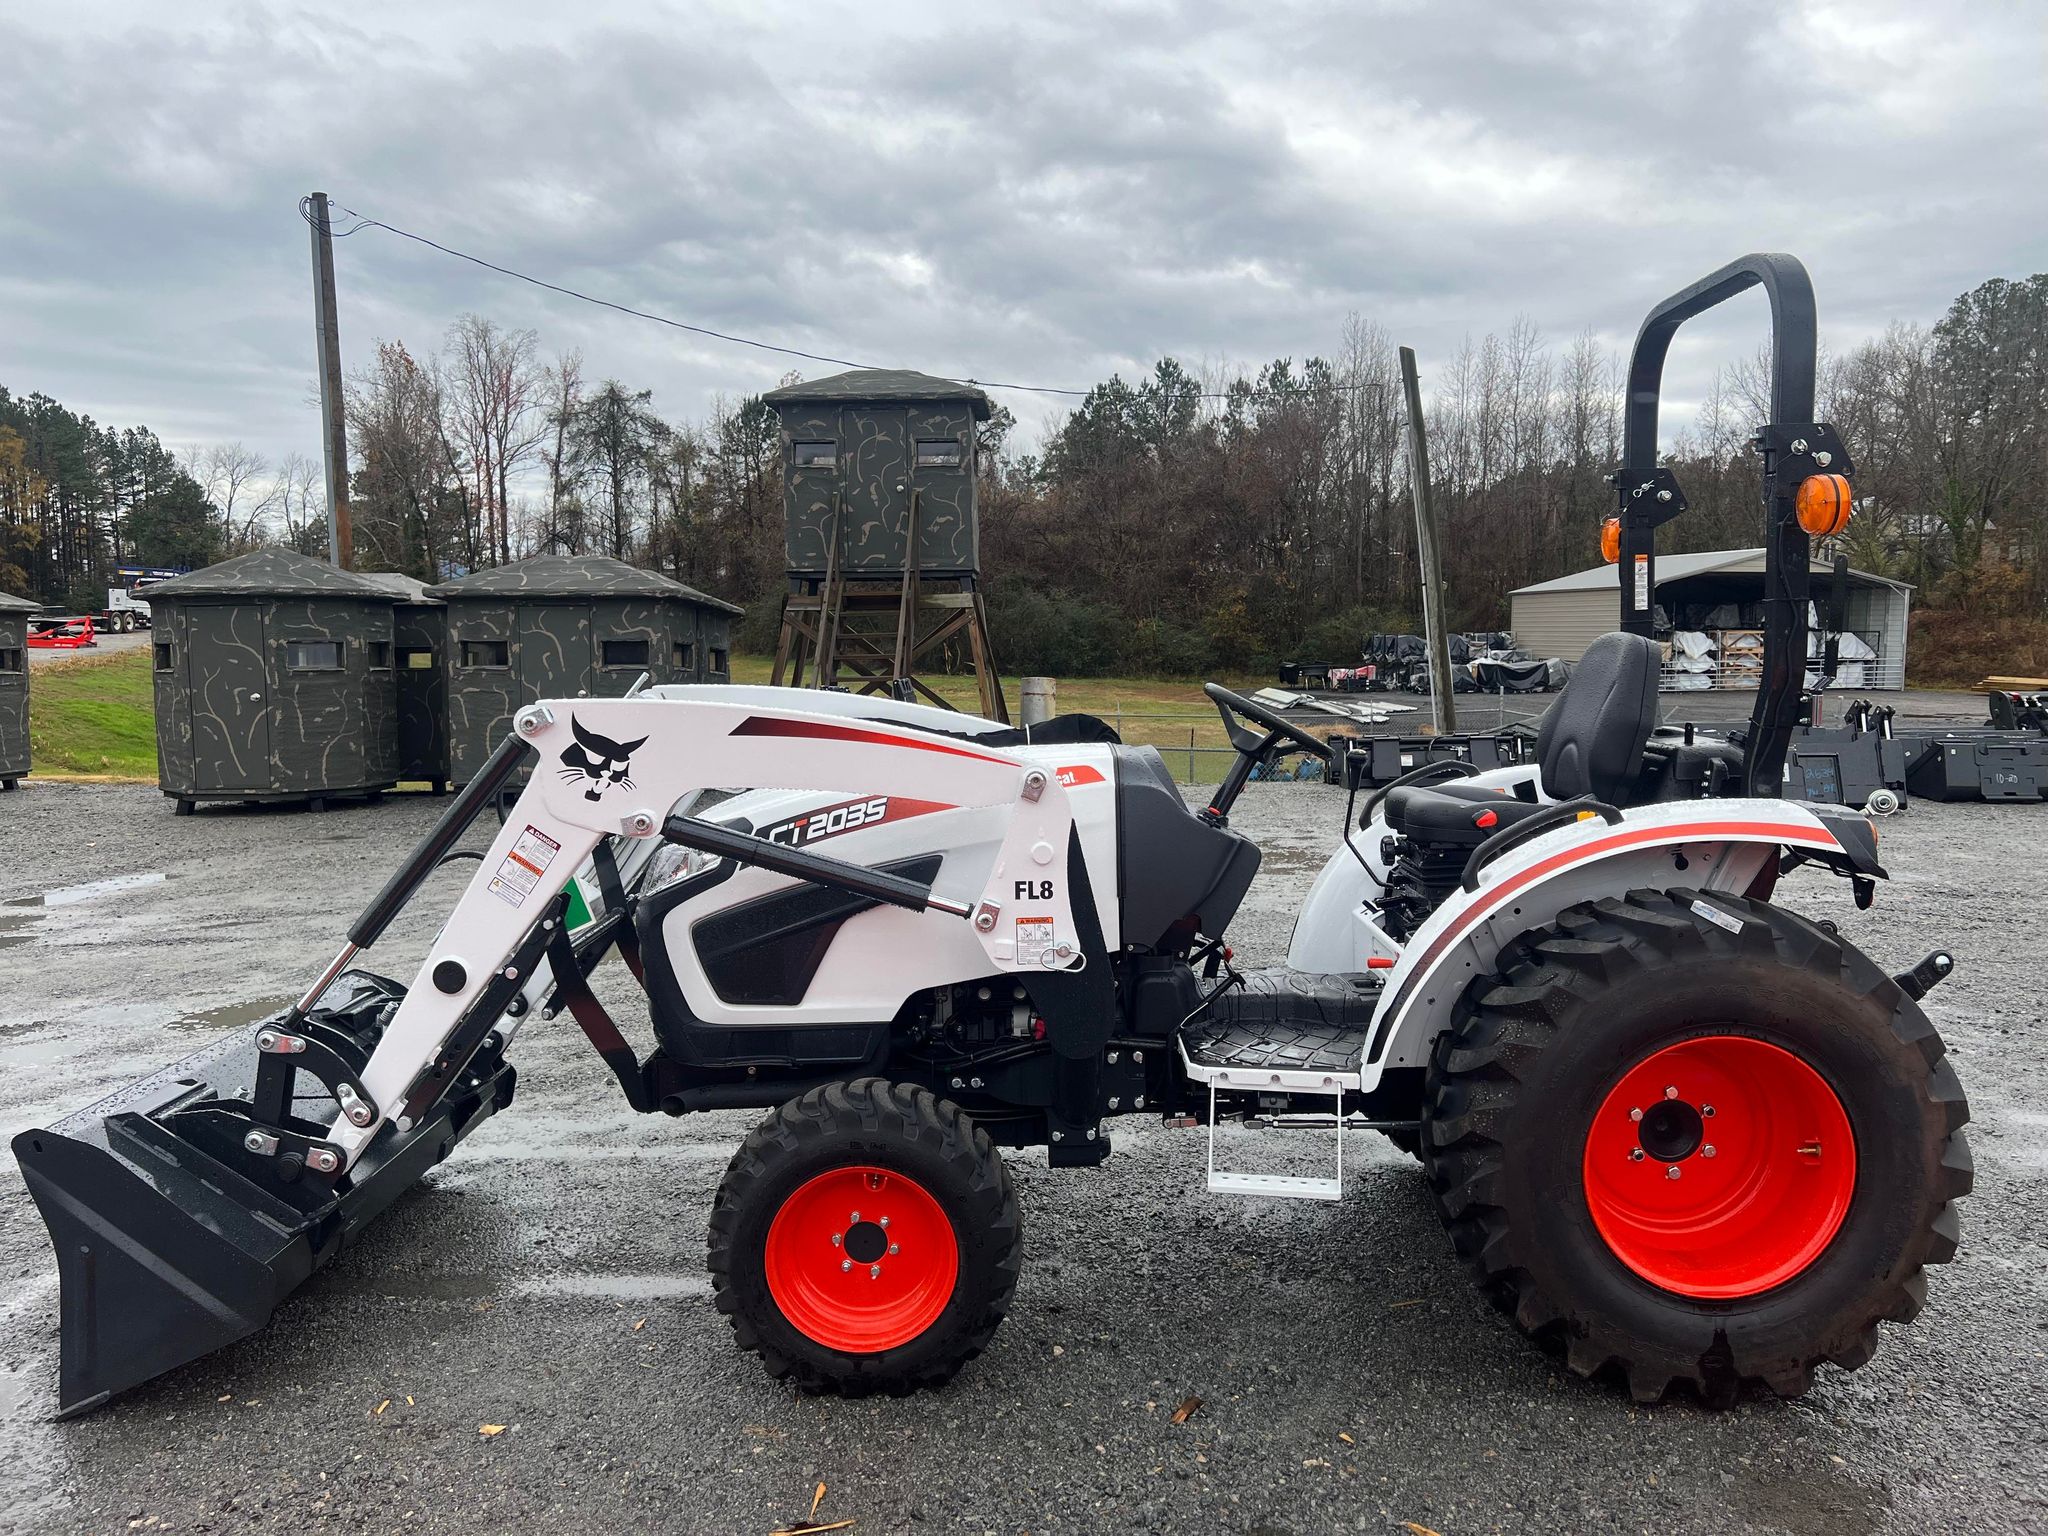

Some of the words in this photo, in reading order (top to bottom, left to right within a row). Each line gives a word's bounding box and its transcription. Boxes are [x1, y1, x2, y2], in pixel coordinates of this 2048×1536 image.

[535, 831, 558, 849] DANGER
[518, 857, 541, 875] WARNING
[1014, 880, 1054, 900] FL8
